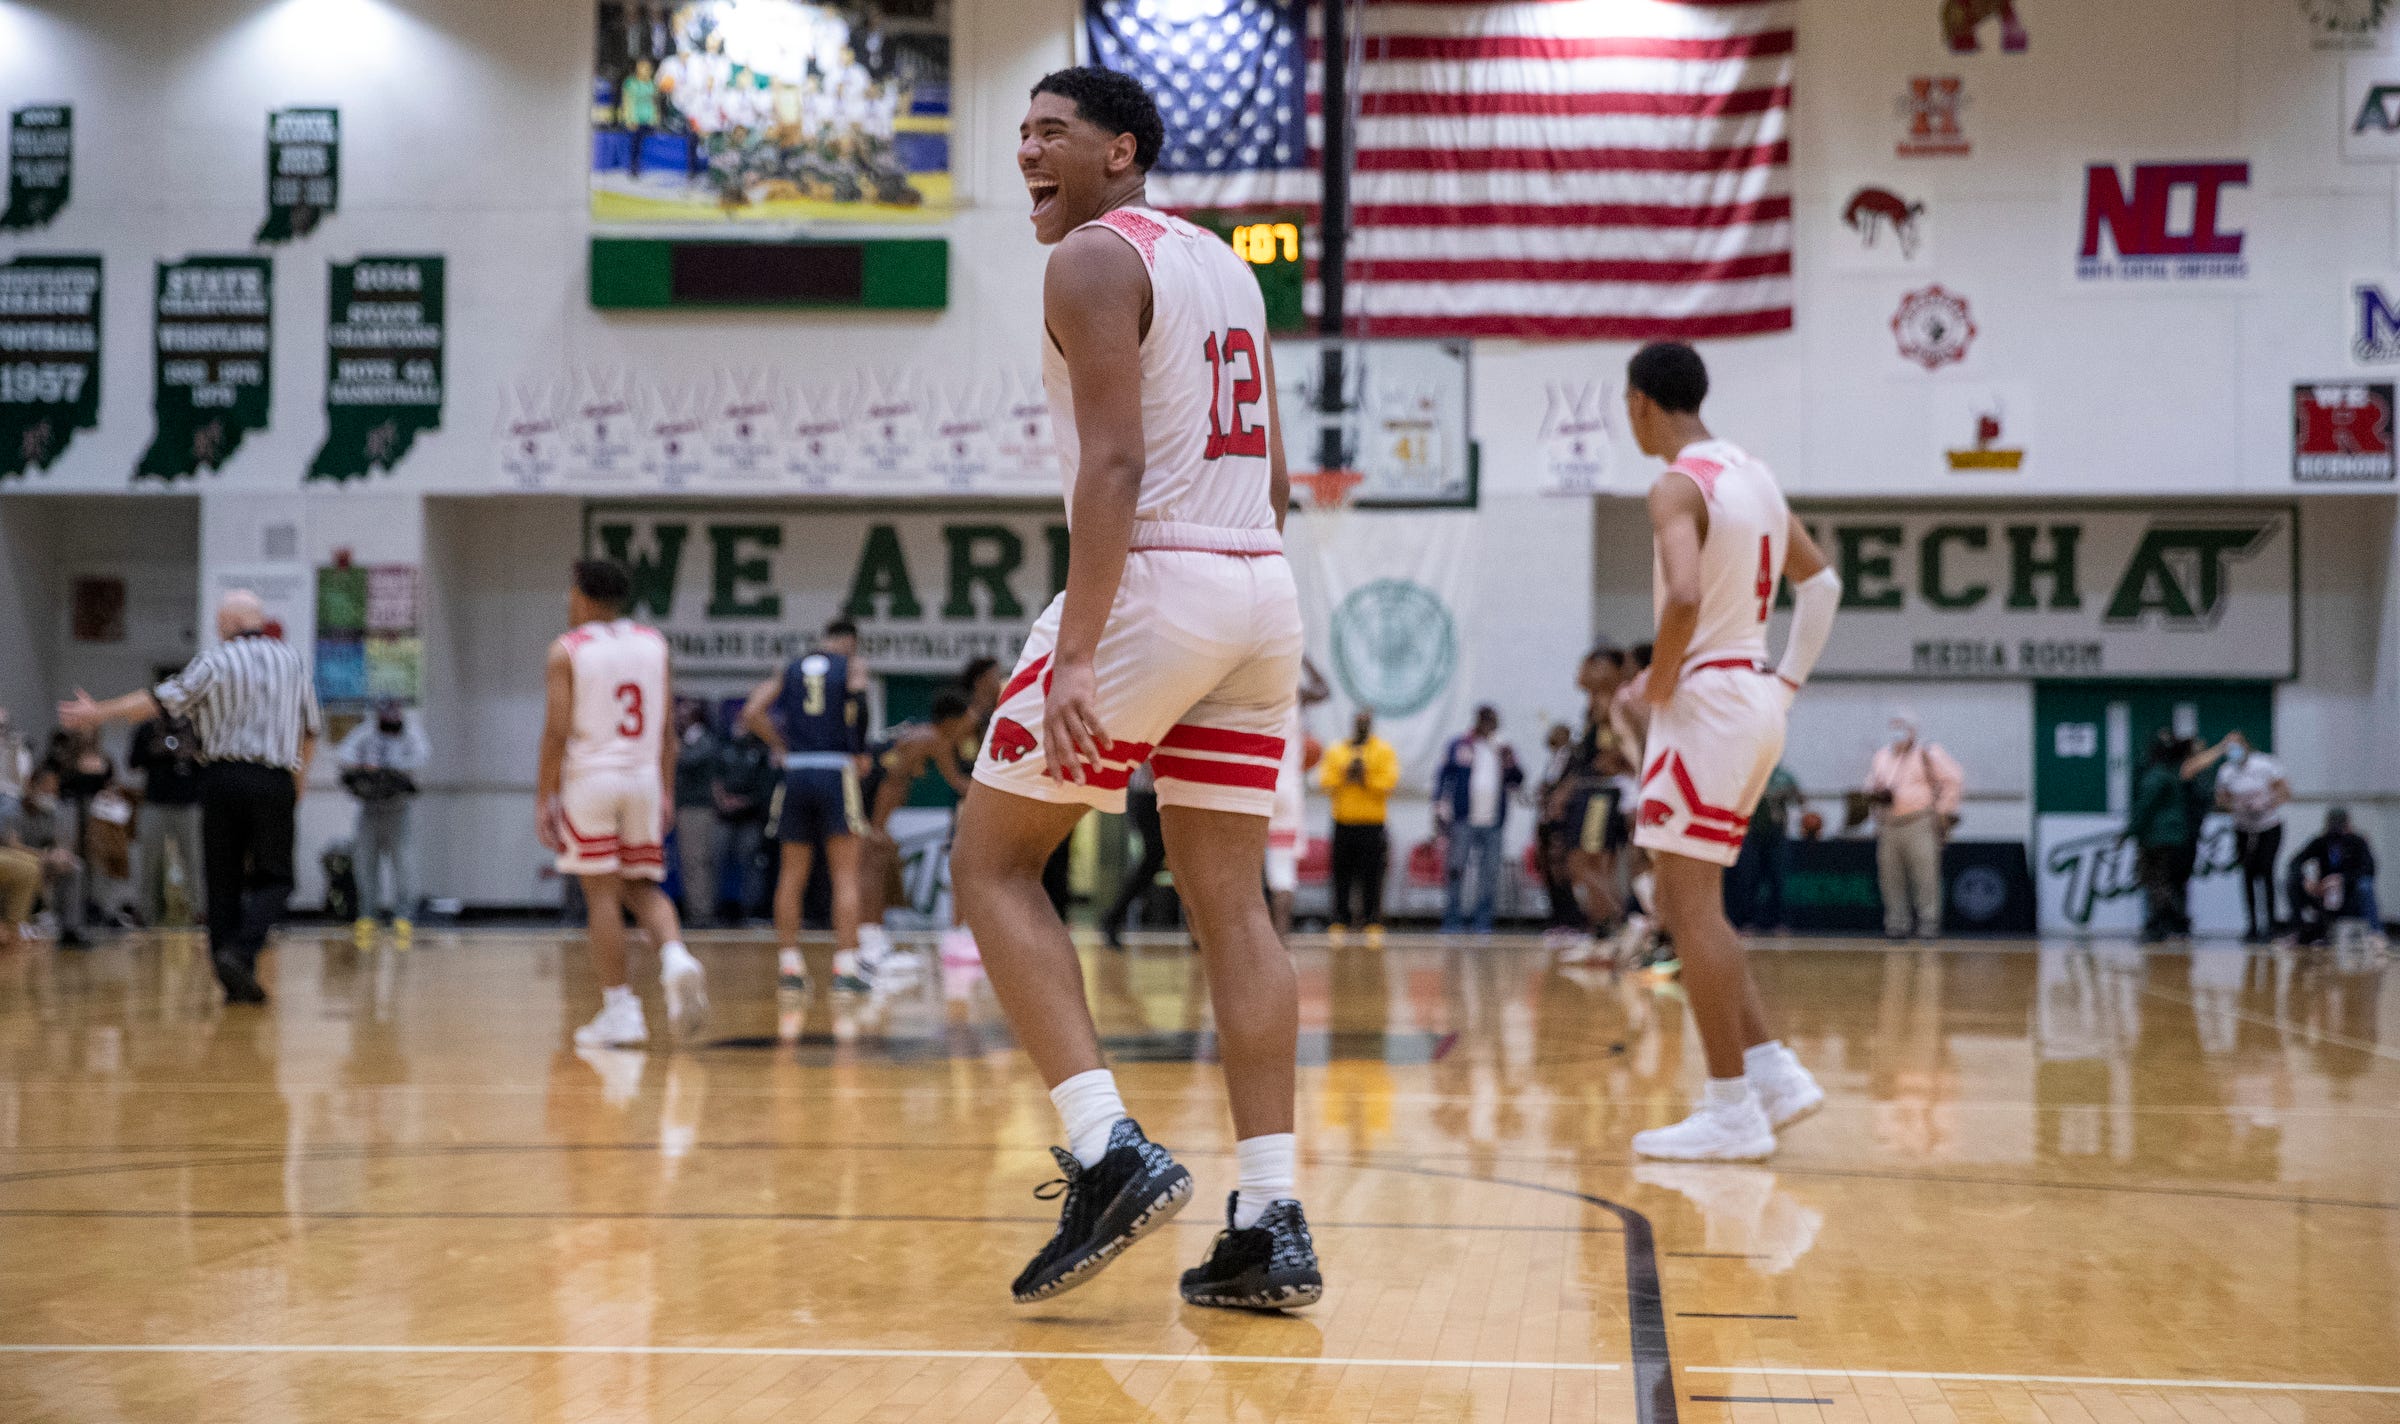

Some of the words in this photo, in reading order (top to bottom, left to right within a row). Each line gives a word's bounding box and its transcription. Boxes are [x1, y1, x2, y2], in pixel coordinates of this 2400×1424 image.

[2079, 163, 2251, 256] NCC
[166, 267, 264, 299] STATE
[0, 361, 88, 404] 1957
[1203, 327, 1267, 461] 12
[600, 522, 783, 618] WE
[842, 522, 1070, 618] AR
[1755, 533, 1771, 623] 4
[1776, 524, 2083, 610] ECH
[1913, 638, 2008, 671] MEDIA
[2018, 638, 2104, 671] ROOM
[614, 682, 644, 738] 3
